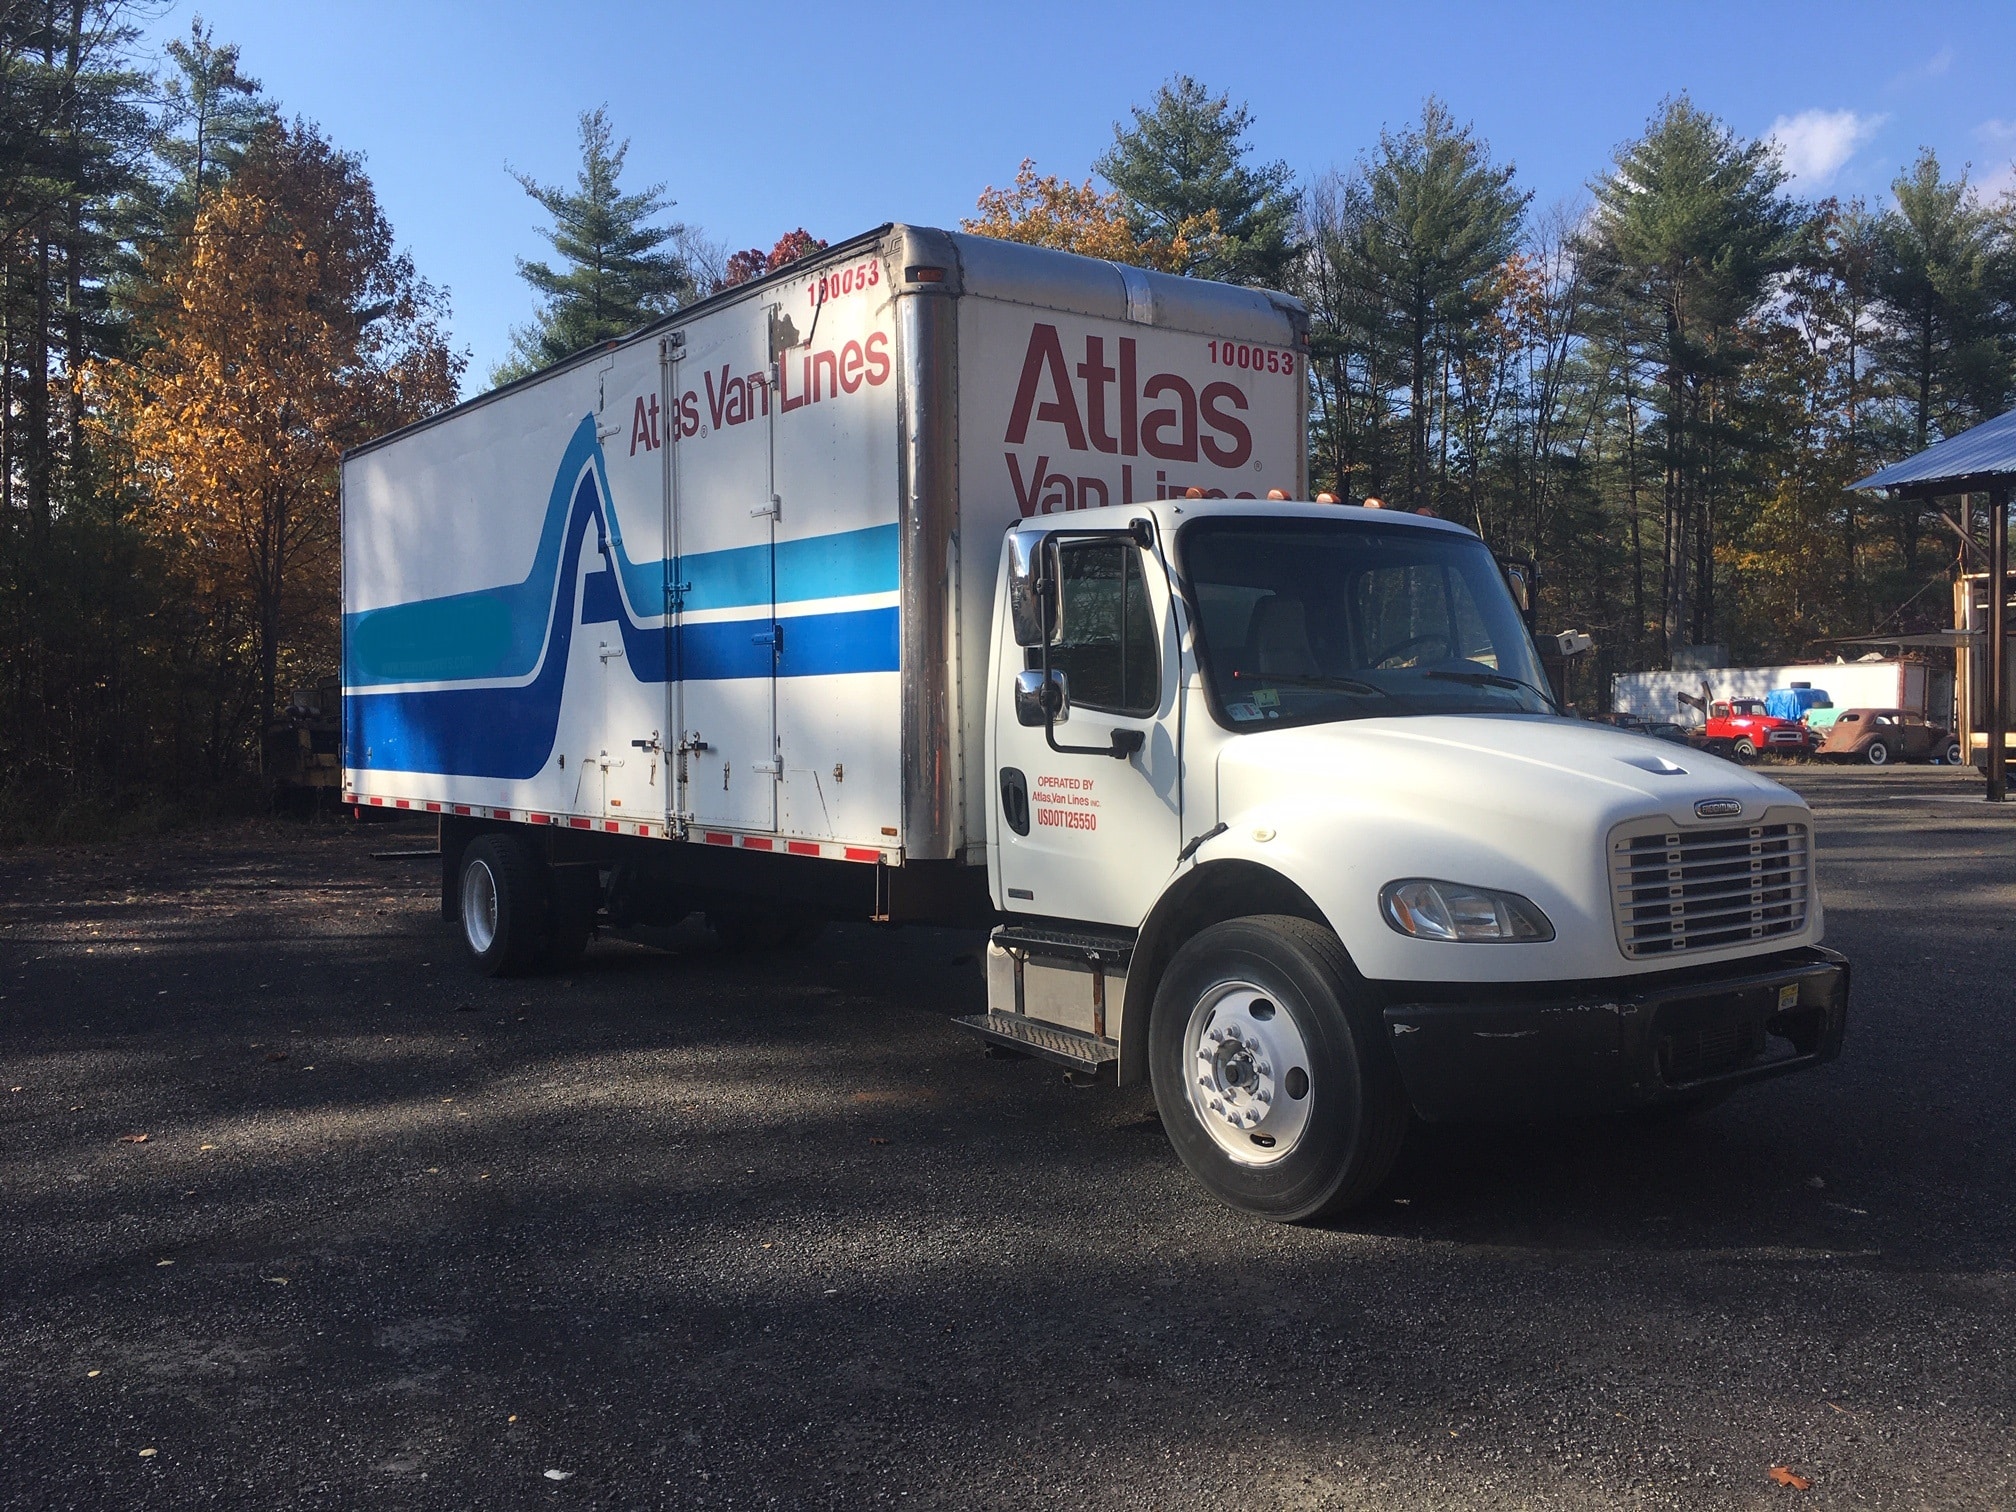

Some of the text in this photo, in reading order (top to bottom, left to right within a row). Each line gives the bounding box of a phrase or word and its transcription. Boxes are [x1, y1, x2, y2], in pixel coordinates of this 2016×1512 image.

[807, 259, 880, 307] 100053
[1207, 340, 1295, 376] 100053
[629, 331, 891, 457] Atas Van Lines
[1004, 322, 1253, 470] Atlas
[1038, 776, 1094, 790] OPERATED BY
[1067, 794, 1089, 806] Lines
[1038, 808, 1096, 830] USDOT125550
